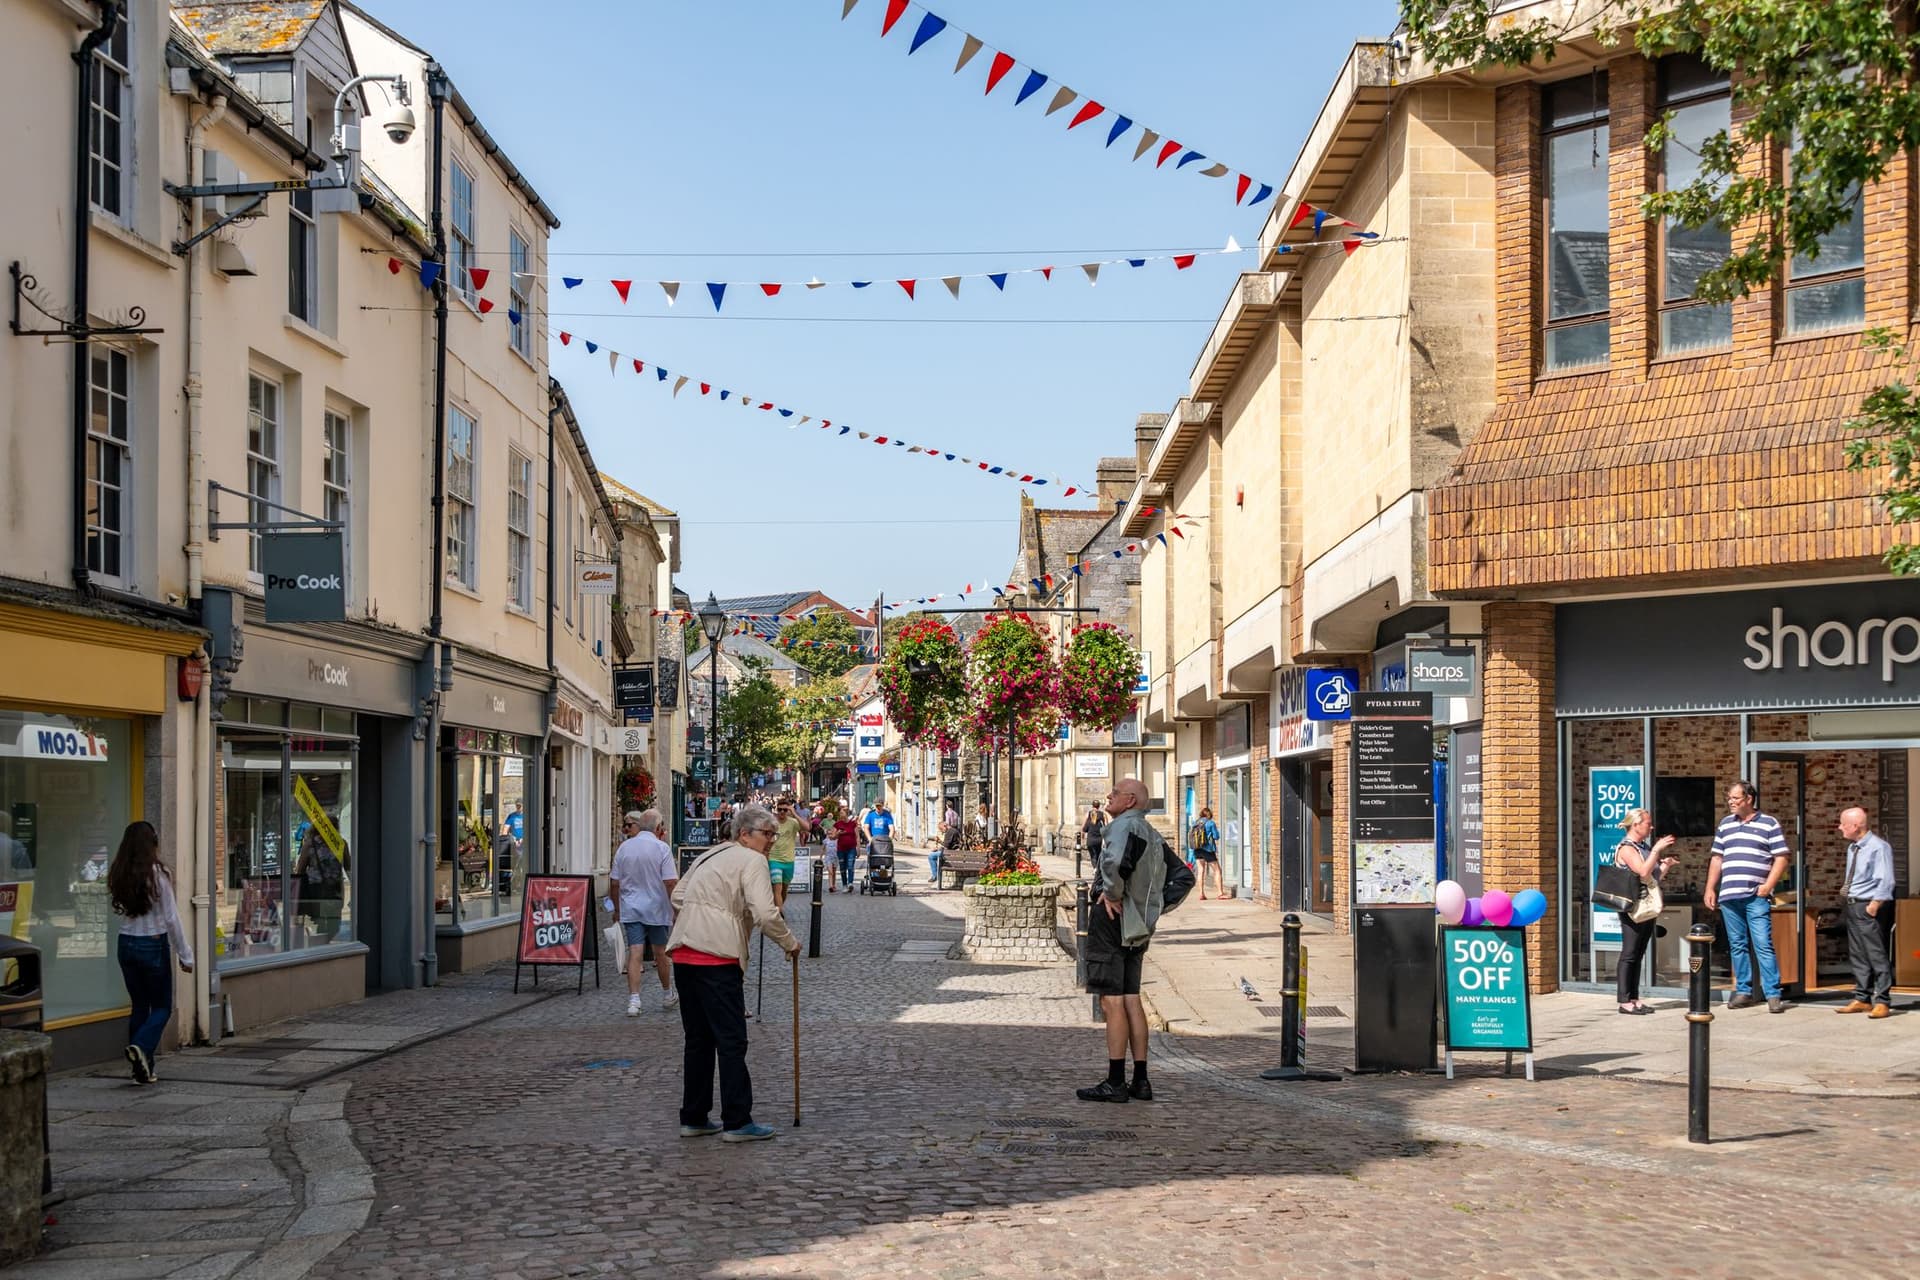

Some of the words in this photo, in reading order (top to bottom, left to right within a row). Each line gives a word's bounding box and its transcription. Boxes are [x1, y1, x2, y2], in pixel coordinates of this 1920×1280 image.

[267, 574, 341, 590] ProCook
[308, 659, 348, 686] ProCook
[1413, 662, 1463, 681] sharps
[1598, 785, 1635, 801] 50%
[533, 907, 571, 925] SALE
[1454, 940, 1514, 963] 50%
[1459, 967, 1512, 990] OFF
[1483, 996, 1517, 1004] RANGES
